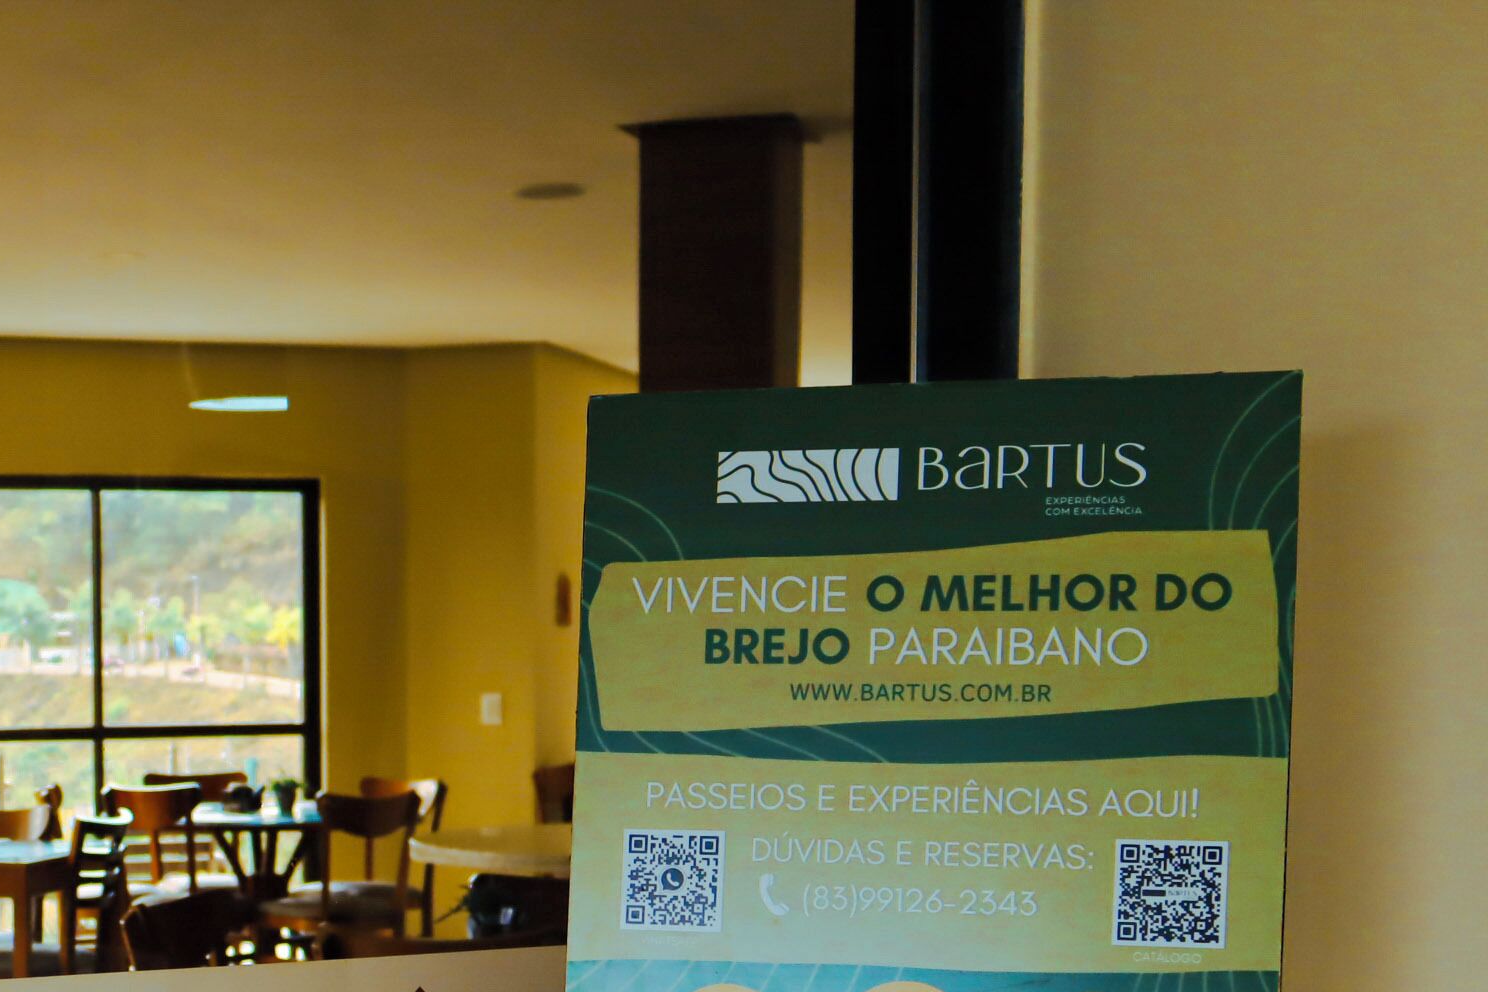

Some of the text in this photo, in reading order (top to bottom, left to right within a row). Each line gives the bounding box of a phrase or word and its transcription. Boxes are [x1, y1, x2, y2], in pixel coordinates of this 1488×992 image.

[1045, 494, 1126, 505] EXPERIÊNCIAS
[1045, 504, 1144, 517] COM EXCELÊNCIA
[631, 572, 1233, 615] VIVENCIE O MELHOR DO
[704, 626, 1149, 667] BREJO PARAIBANO
[789, 682, 1053, 703] WWW.BARTUS.COM.BR
[645, 778, 1200, 819] PASSEIOS E EXPERIÊNCIAS AQUI!
[751, 831, 1095, 871] DÚVIDAS E RESERVAS:
[802, 882, 1040, 918] (83)99126-2343
[1132, 951, 1203, 965] CATÁLOGO
